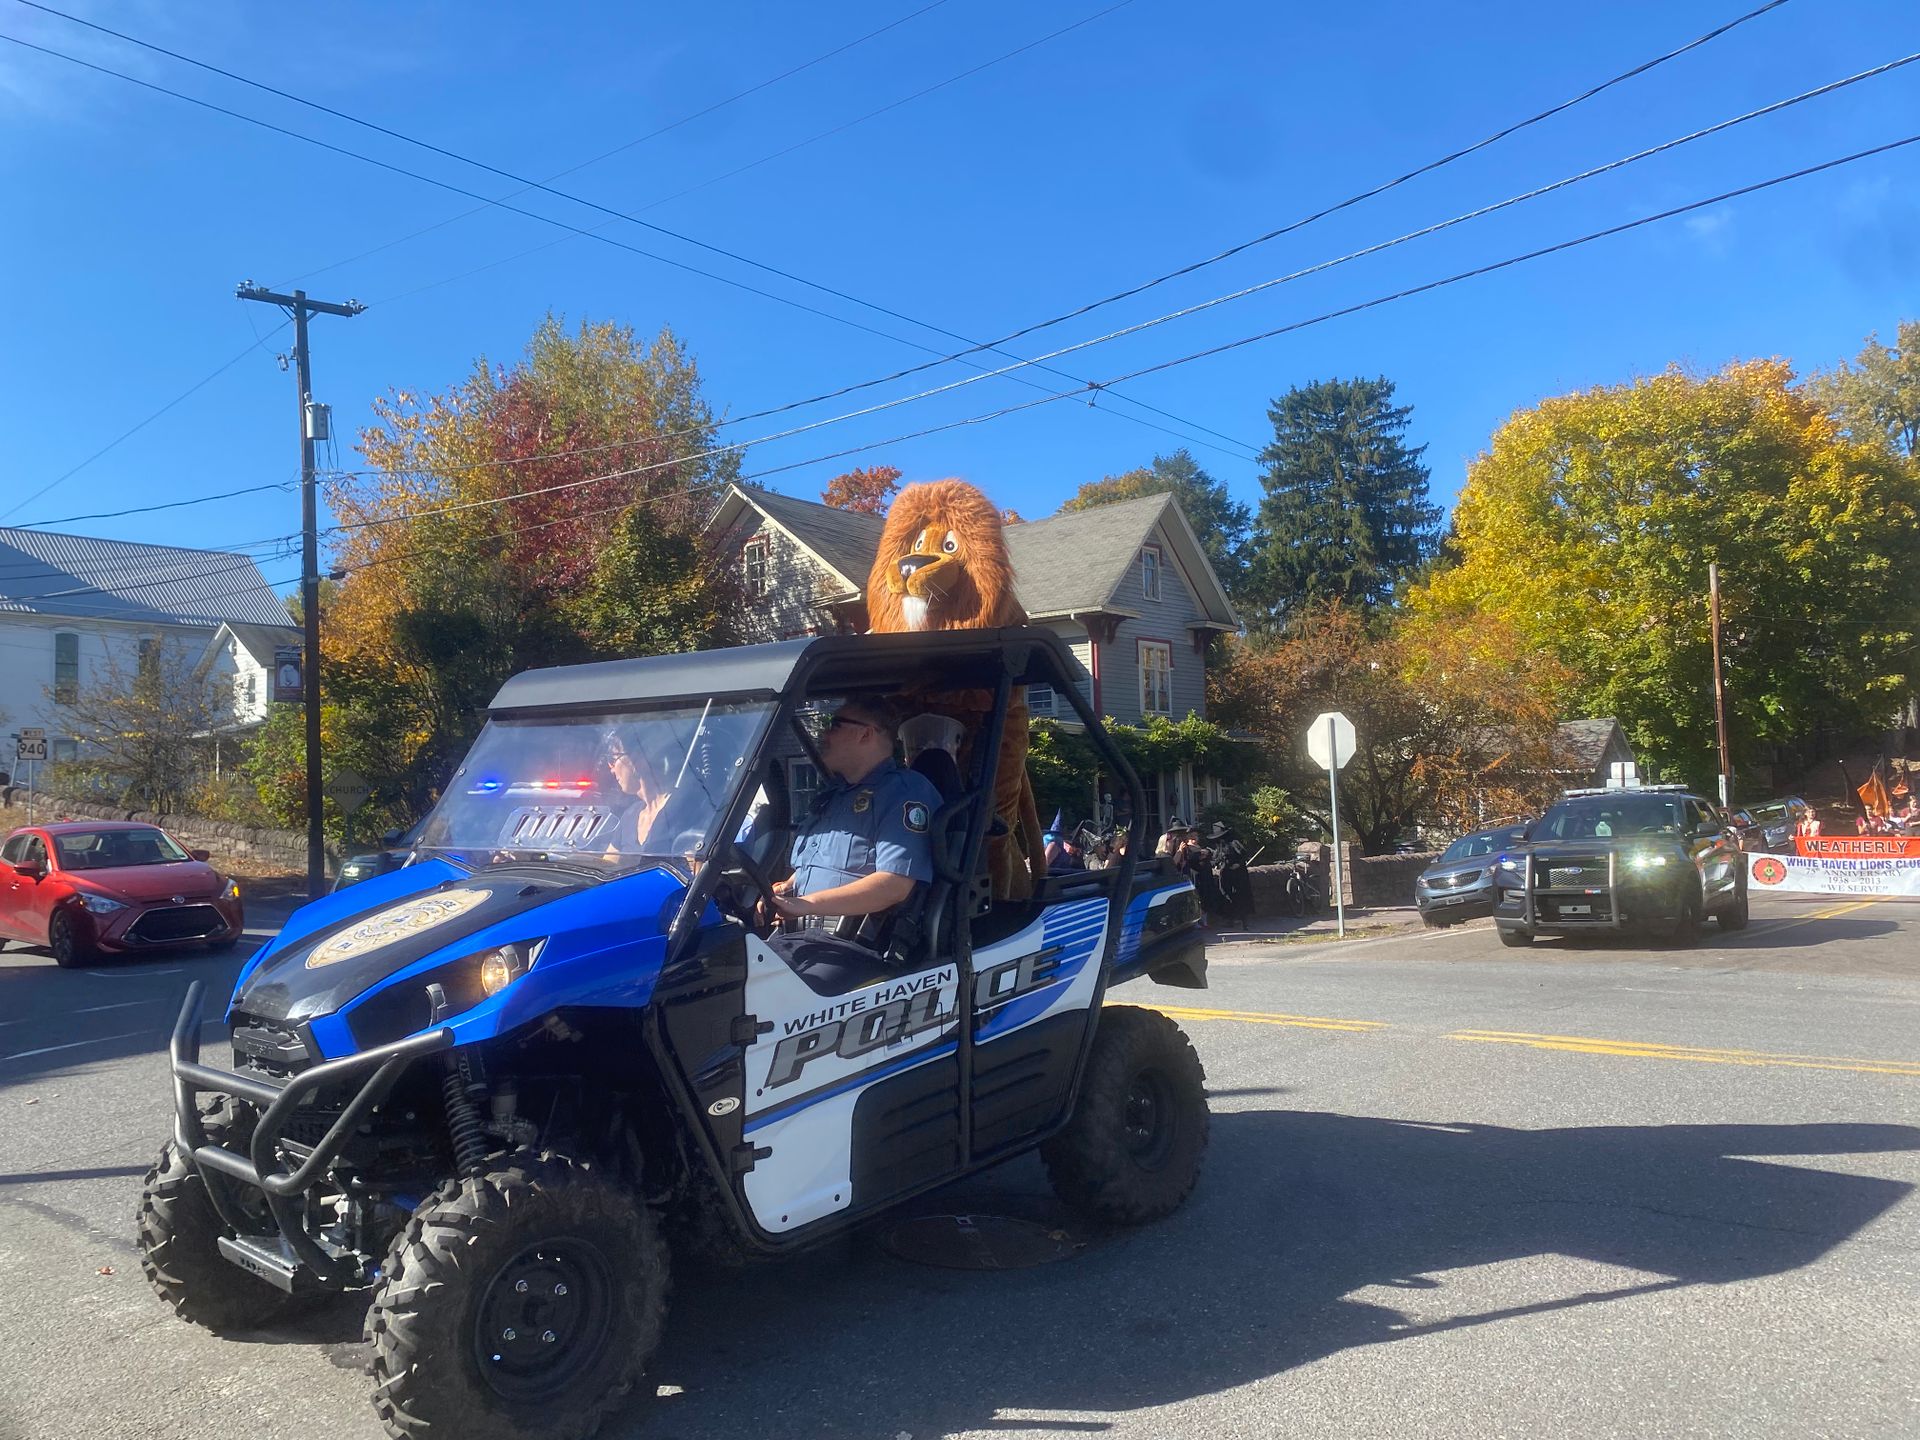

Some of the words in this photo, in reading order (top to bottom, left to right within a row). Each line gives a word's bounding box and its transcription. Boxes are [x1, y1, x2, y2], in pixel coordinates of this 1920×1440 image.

[19, 743, 45, 754] 940
[329, 785, 369, 794] CHURCH
[1806, 840, 1907, 853] WEATHERLY
[1786, 857, 1819, 868] WHITE
[1821, 859, 1857, 870] HAVEN
[1860, 860, 1892, 870] LIONS
[1825, 869, 1902, 877] ANNIVERSARY
[1828, 876, 1849, 884] 1938
[1859, 877, 1881, 885] 2013
[783, 996, 866, 1035] WHITE
[874, 969, 952, 1005] HAVEN
